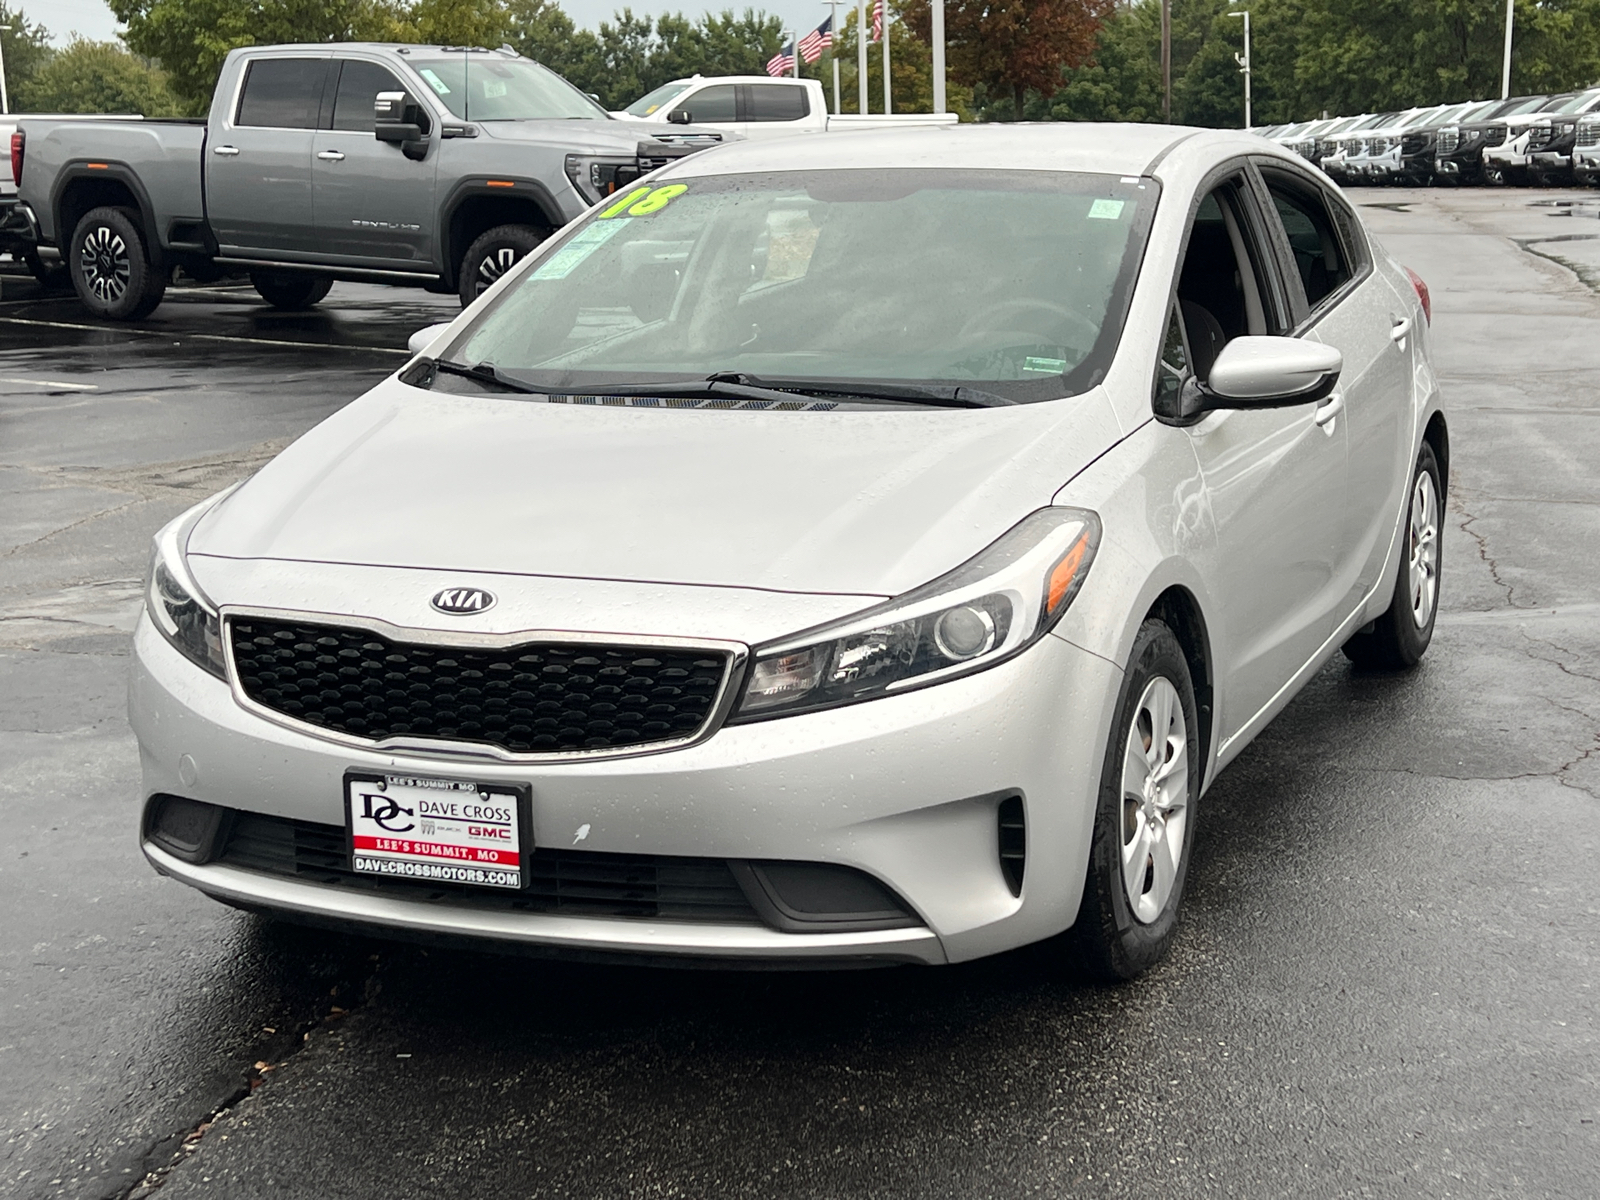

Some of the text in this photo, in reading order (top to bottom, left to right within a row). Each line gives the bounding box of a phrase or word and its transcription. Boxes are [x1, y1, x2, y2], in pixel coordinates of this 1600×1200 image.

[598, 184, 689, 219] 18
[437, 590, 483, 609] KIA
[387, 776, 475, 792] LEE'S SUMMIT MO
[419, 801, 511, 822] DAVE CROSS
[468, 826, 511, 840] GMC
[376, 838, 499, 861] LEE'S SUMMIT, MO
[355, 858, 518, 886] DAVECROSSMOTORS.COM
